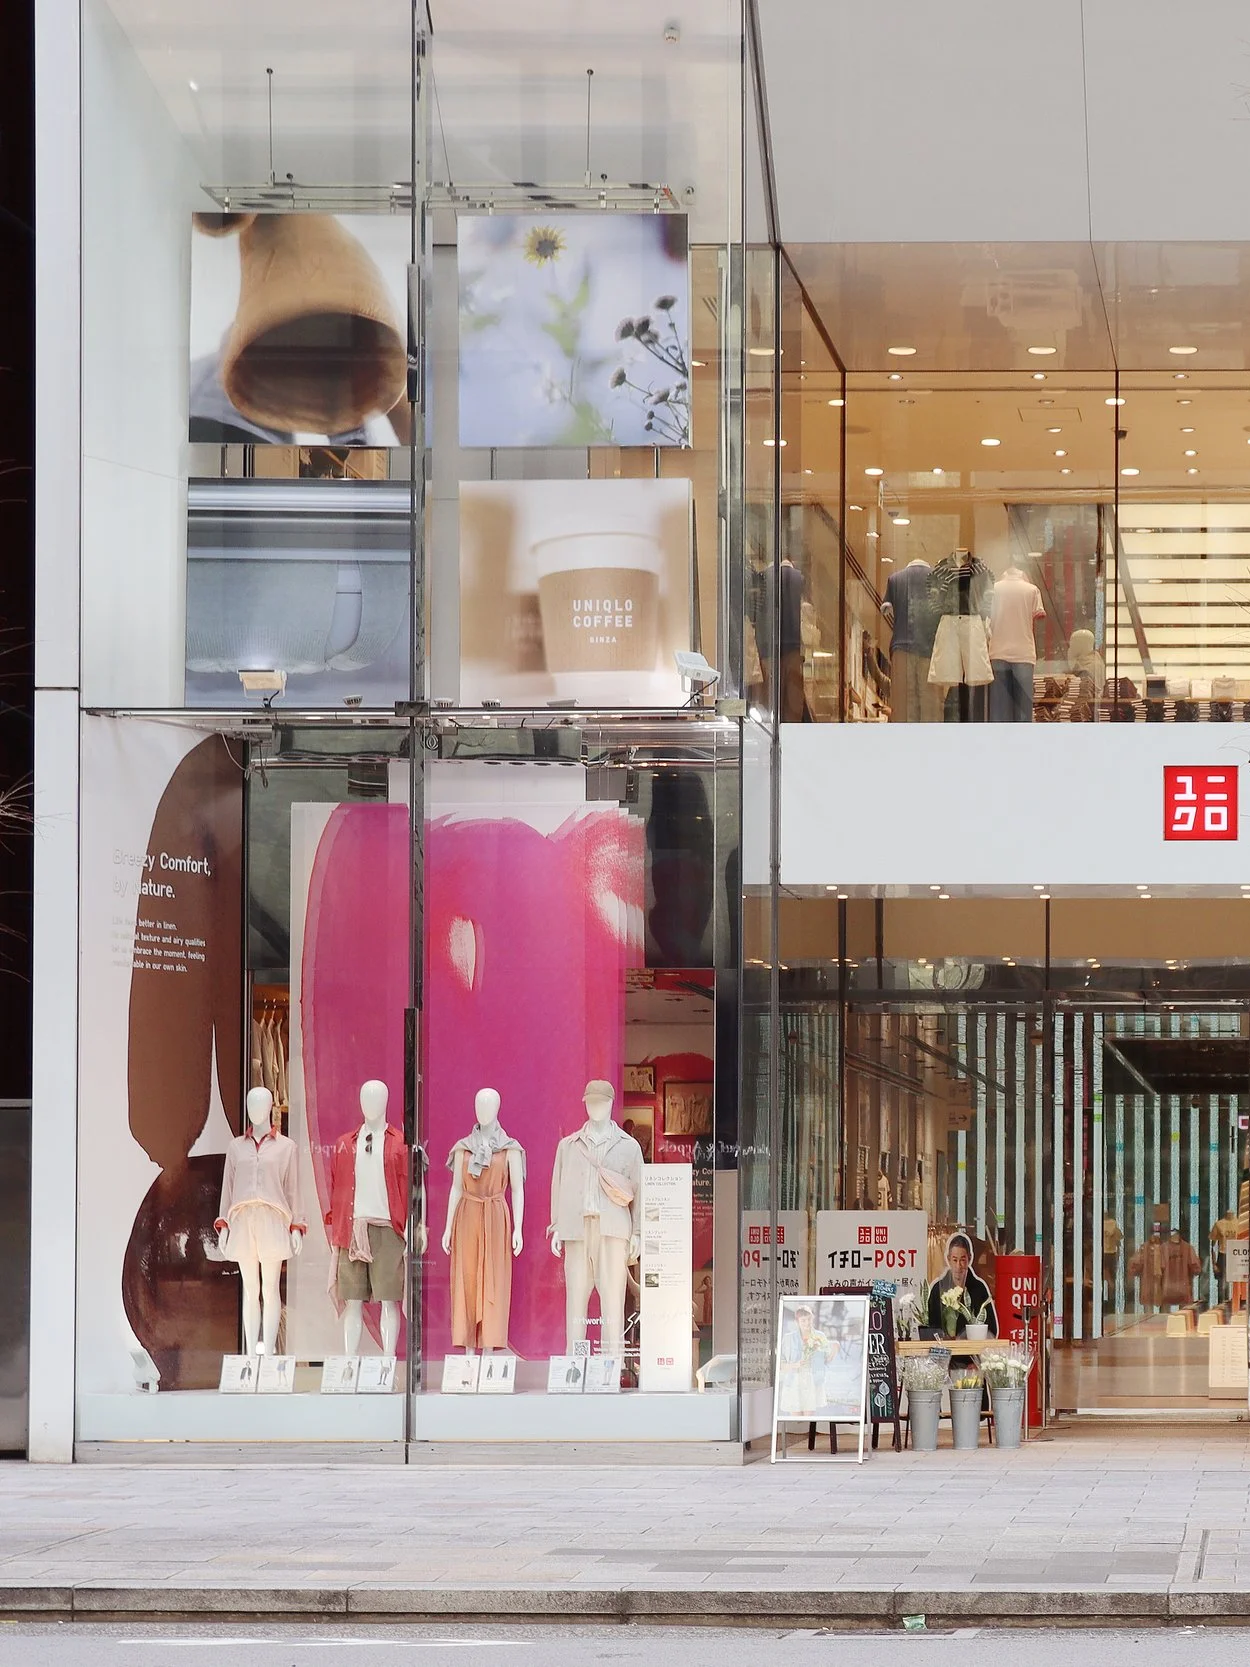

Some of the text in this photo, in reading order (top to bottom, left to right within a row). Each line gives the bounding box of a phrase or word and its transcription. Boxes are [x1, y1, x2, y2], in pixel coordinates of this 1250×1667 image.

[573, 599, 633, 613] UNIQLO
[573, 615, 633, 628] COFFEE
[113, 849, 211, 876] Breezy Comfort,
[139, 918, 155, 928] better
[156, 921, 162, 929] in
[163, 921, 178, 930] linen.
[141, 932, 160, 943] texture
[161, 935, 171, 944] and
[173, 936, 184, 947] airy
[153, 947, 162, 957] the
[152, 962, 161, 970] our
[1011, 1277, 1037, 1291] UNI
[1011, 1293, 1038, 1310] QLO
